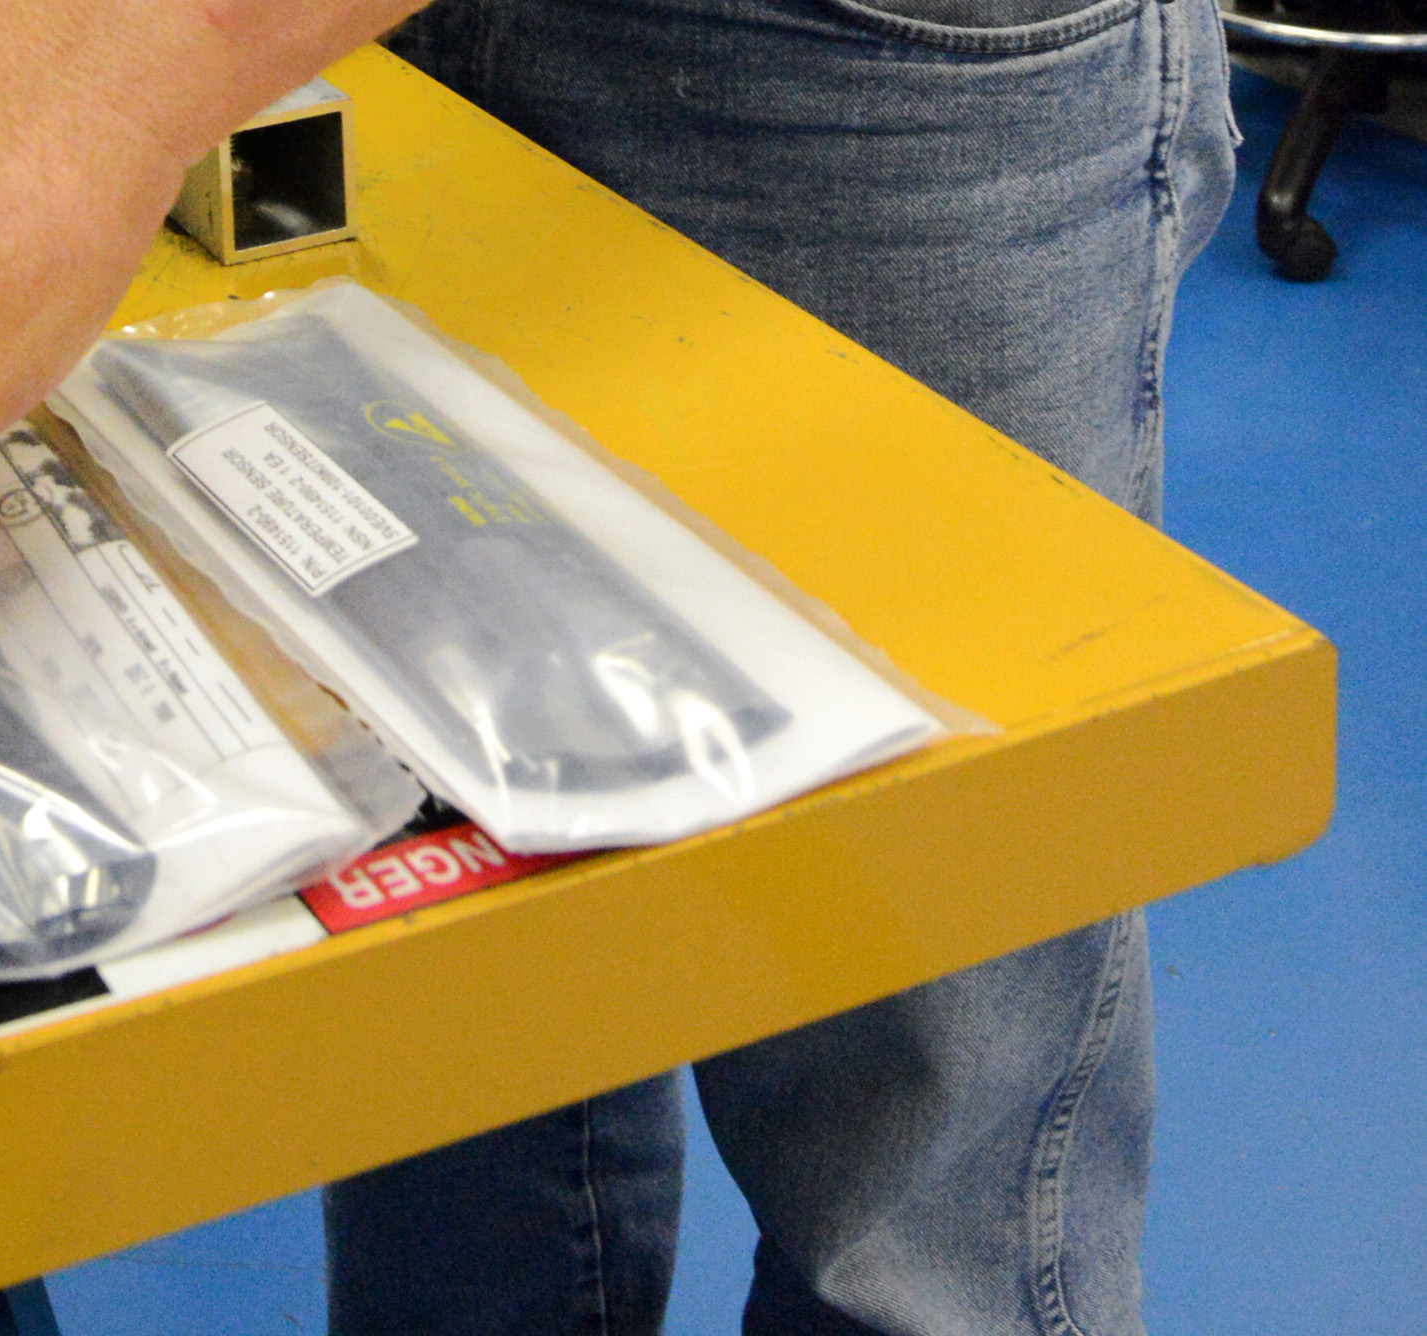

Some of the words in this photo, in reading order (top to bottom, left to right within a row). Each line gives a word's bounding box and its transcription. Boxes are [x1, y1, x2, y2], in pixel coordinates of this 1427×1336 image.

[219, 446, 273, 491] SENSOR
[260, 450, 285, 469] EA
[263, 487, 352, 565] TEMPERATURE
[340, 524, 376, 551] NSN:
[327, 829, 506, 911] NGER
